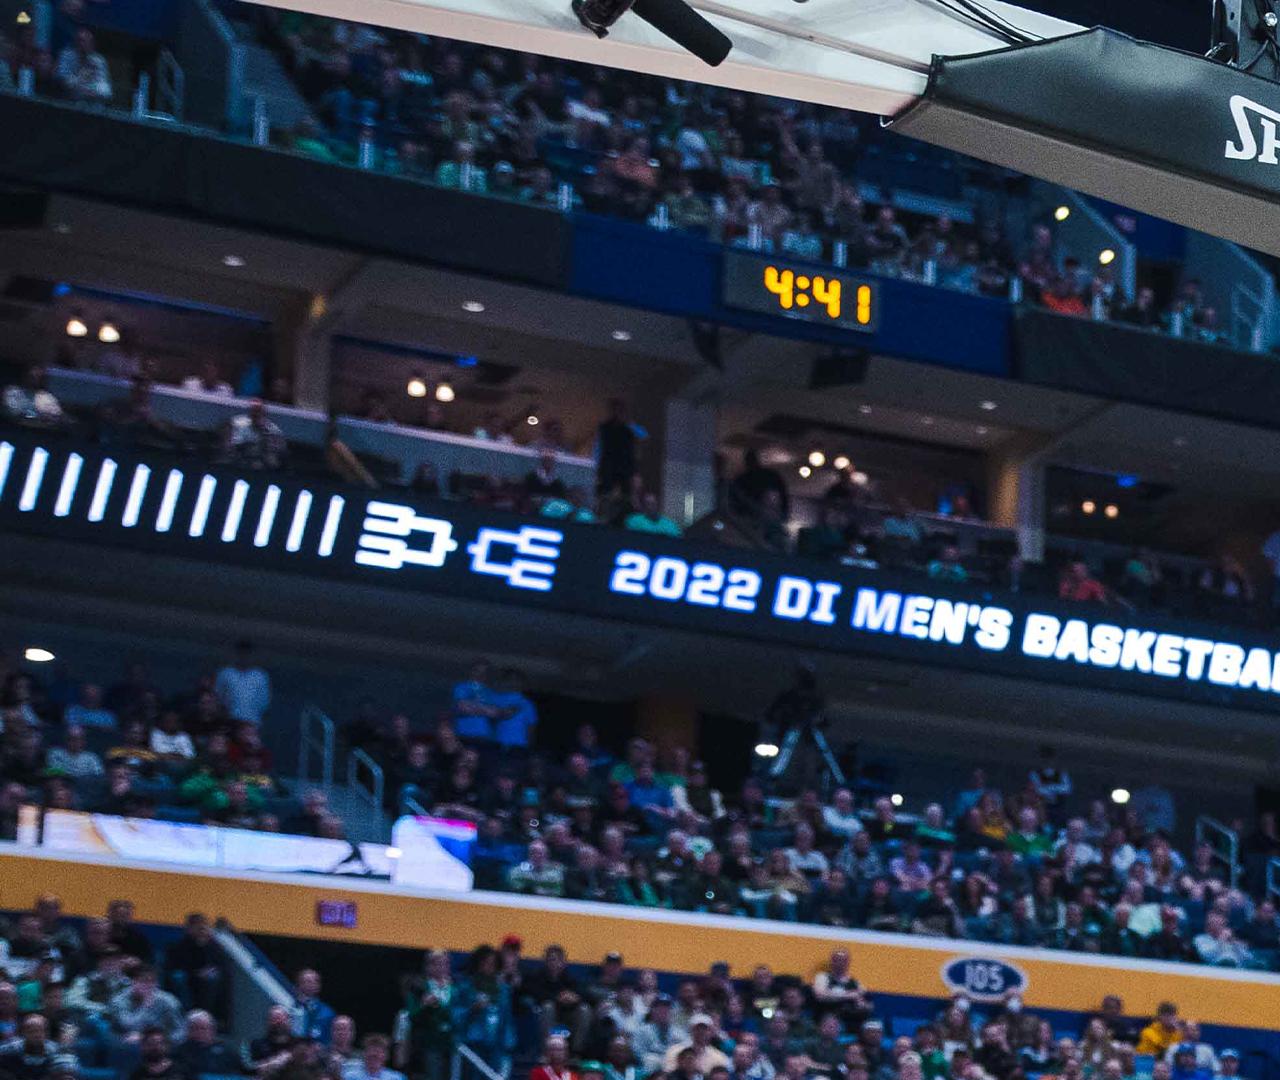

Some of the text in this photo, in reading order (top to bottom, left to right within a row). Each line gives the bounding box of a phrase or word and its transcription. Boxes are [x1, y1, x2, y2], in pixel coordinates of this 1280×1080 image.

[764, 265, 871, 325] 4:41
[609, 549, 762, 613] 2022
[772, 574, 843, 625] DI
[850, 587, 1014, 651] MEN'S
